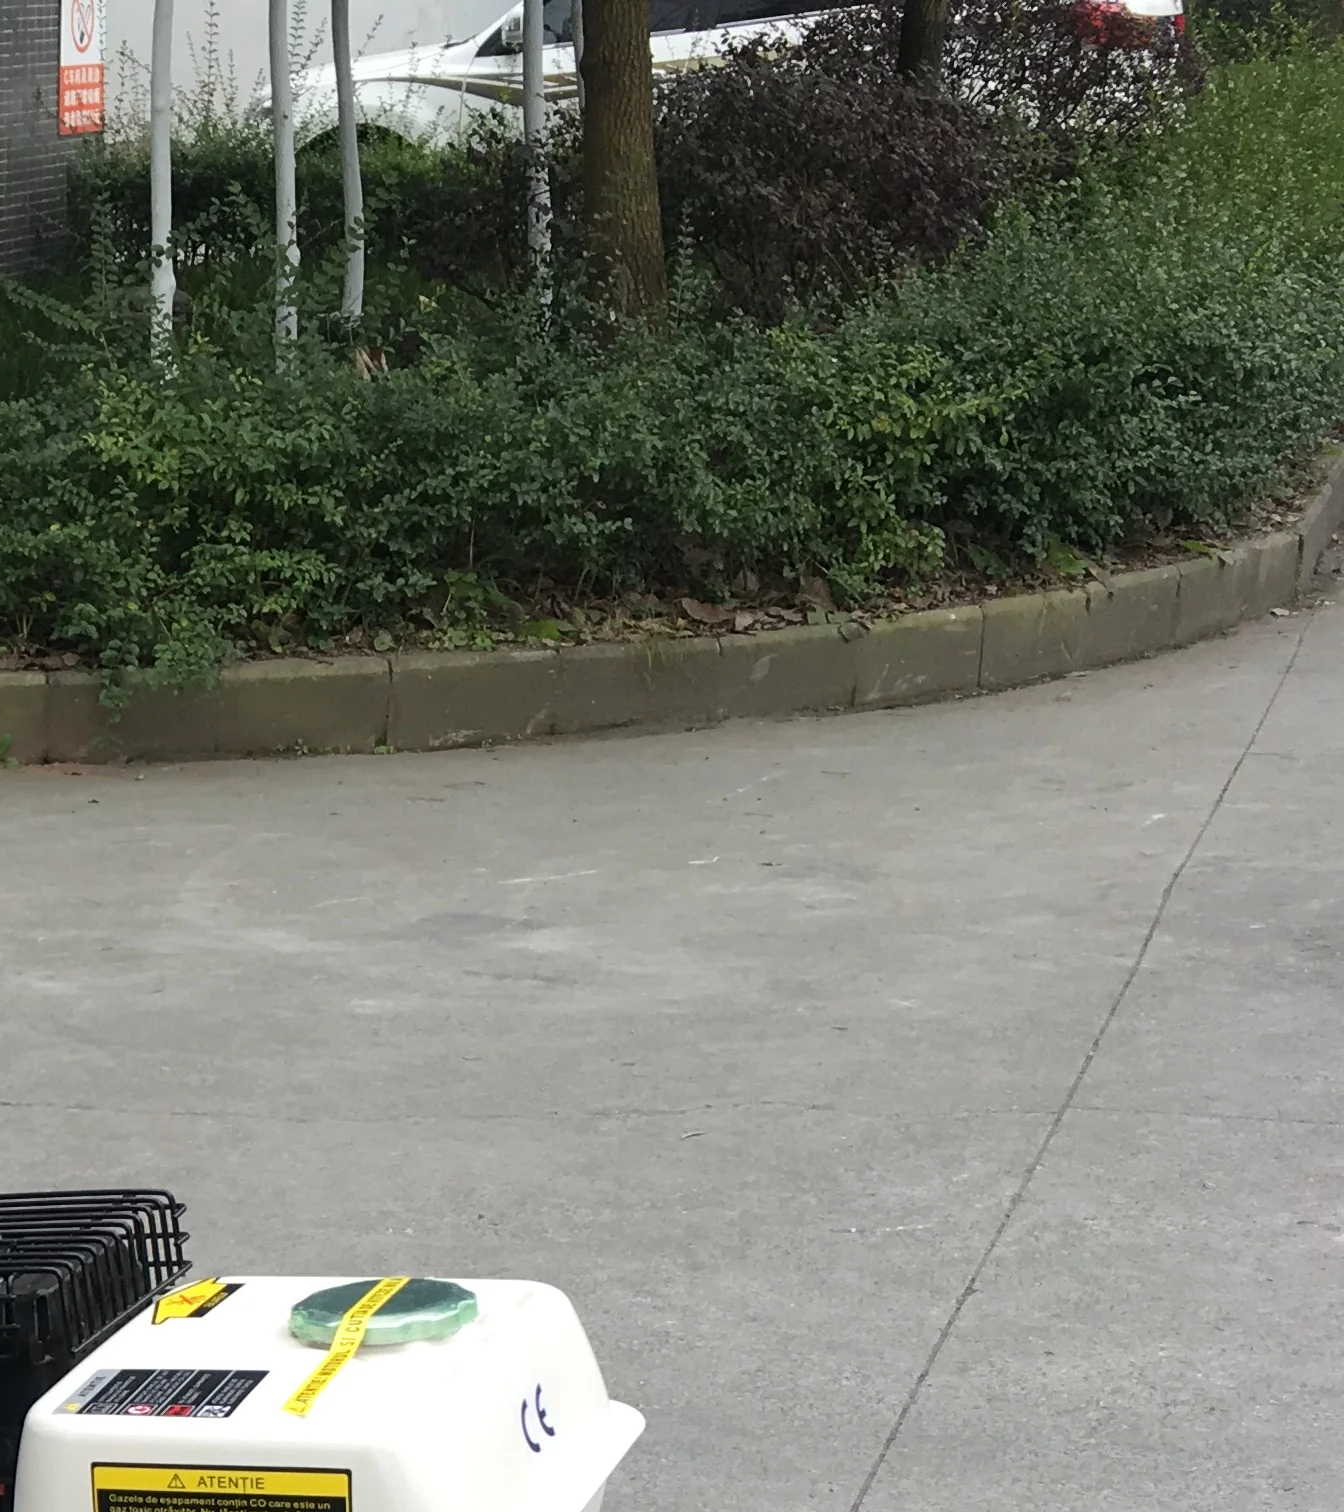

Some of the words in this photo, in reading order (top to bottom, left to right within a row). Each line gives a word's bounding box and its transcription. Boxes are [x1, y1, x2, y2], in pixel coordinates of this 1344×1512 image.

[109, 1493, 144, 1504] Gazele
[145, 1495, 158, 1504] de
[249, 1498, 267, 1508] CO
[268, 1500, 291, 1509] care
[293, 1501, 315, 1510] este
[317, 1502, 331, 1510] un
